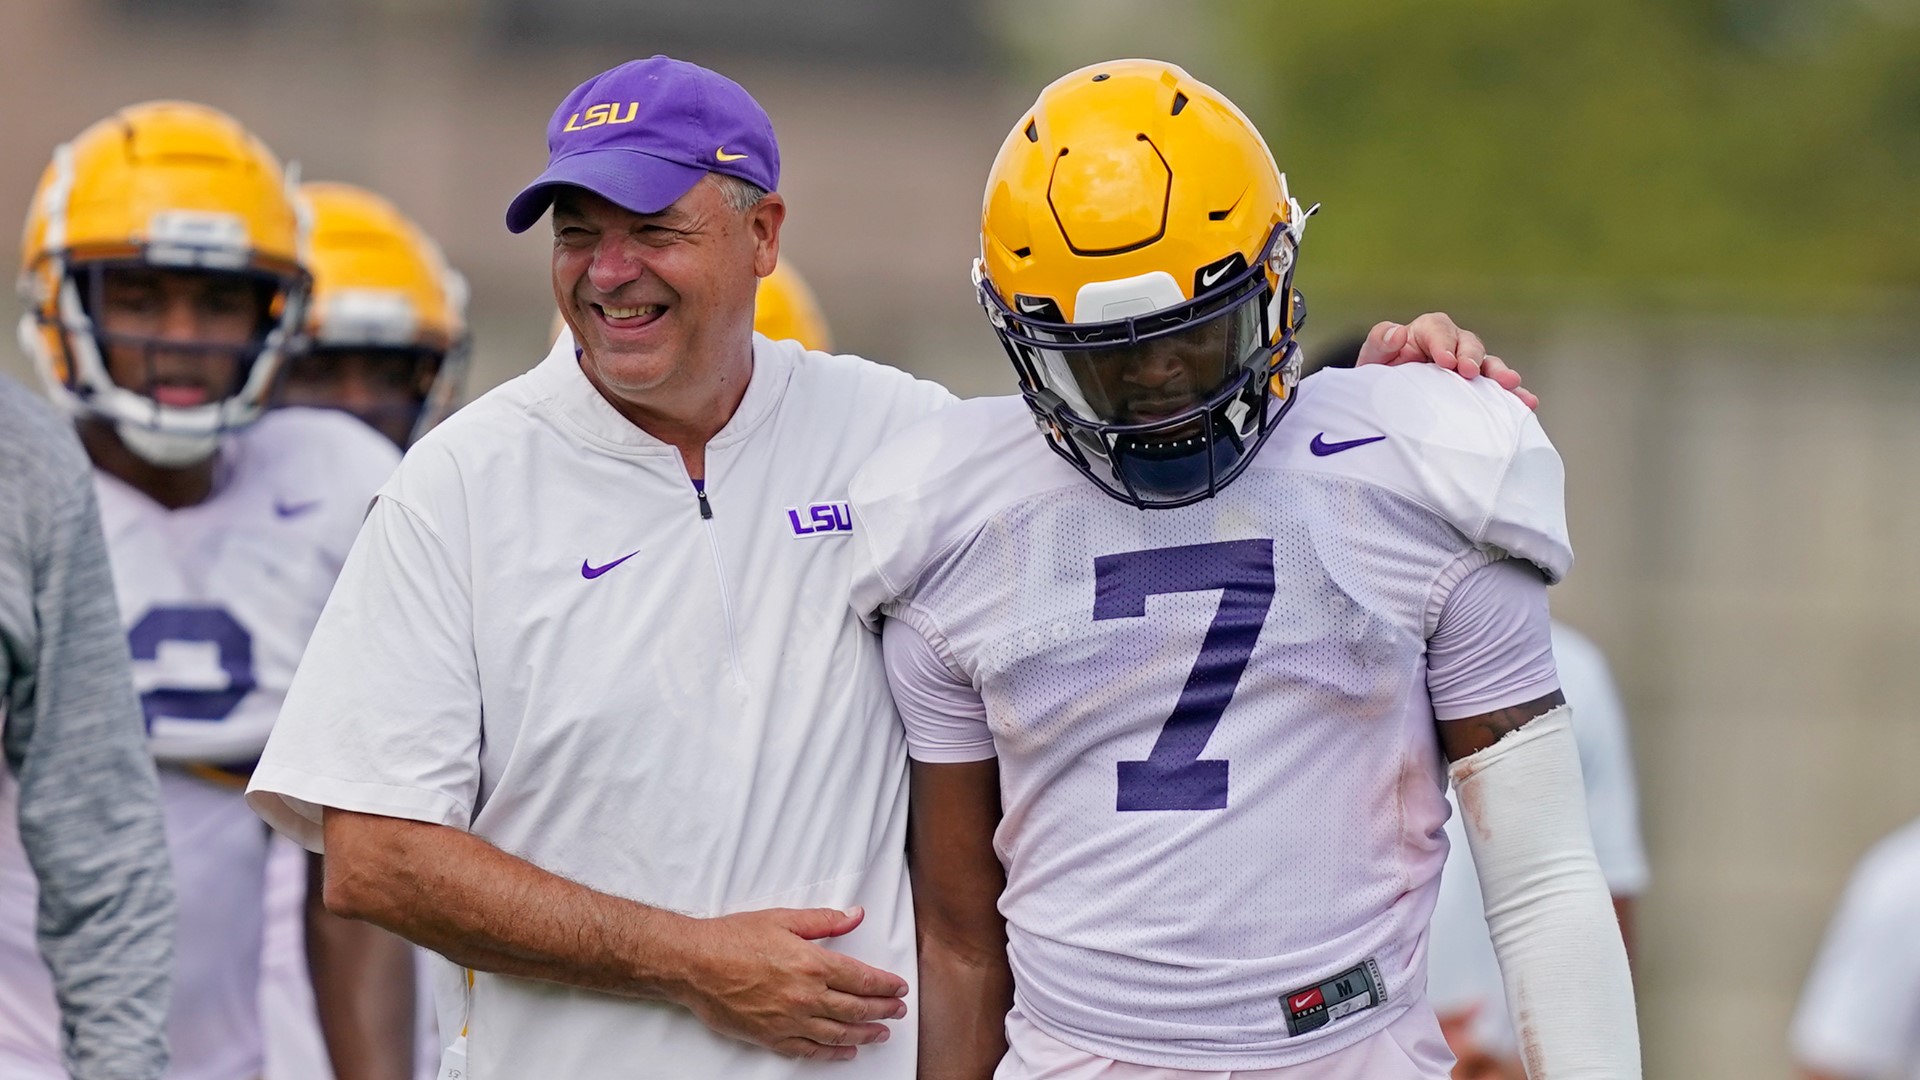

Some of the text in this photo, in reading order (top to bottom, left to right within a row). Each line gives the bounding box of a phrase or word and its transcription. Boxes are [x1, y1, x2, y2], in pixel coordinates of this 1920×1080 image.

[563, 102, 639, 133] LSU
[788, 504, 853, 535] LSU
[127, 607, 255, 738] 2
[1093, 538, 1275, 812] 7
[1335, 979, 1353, 998] M
[1296, 1004, 1323, 1018] TEAM
